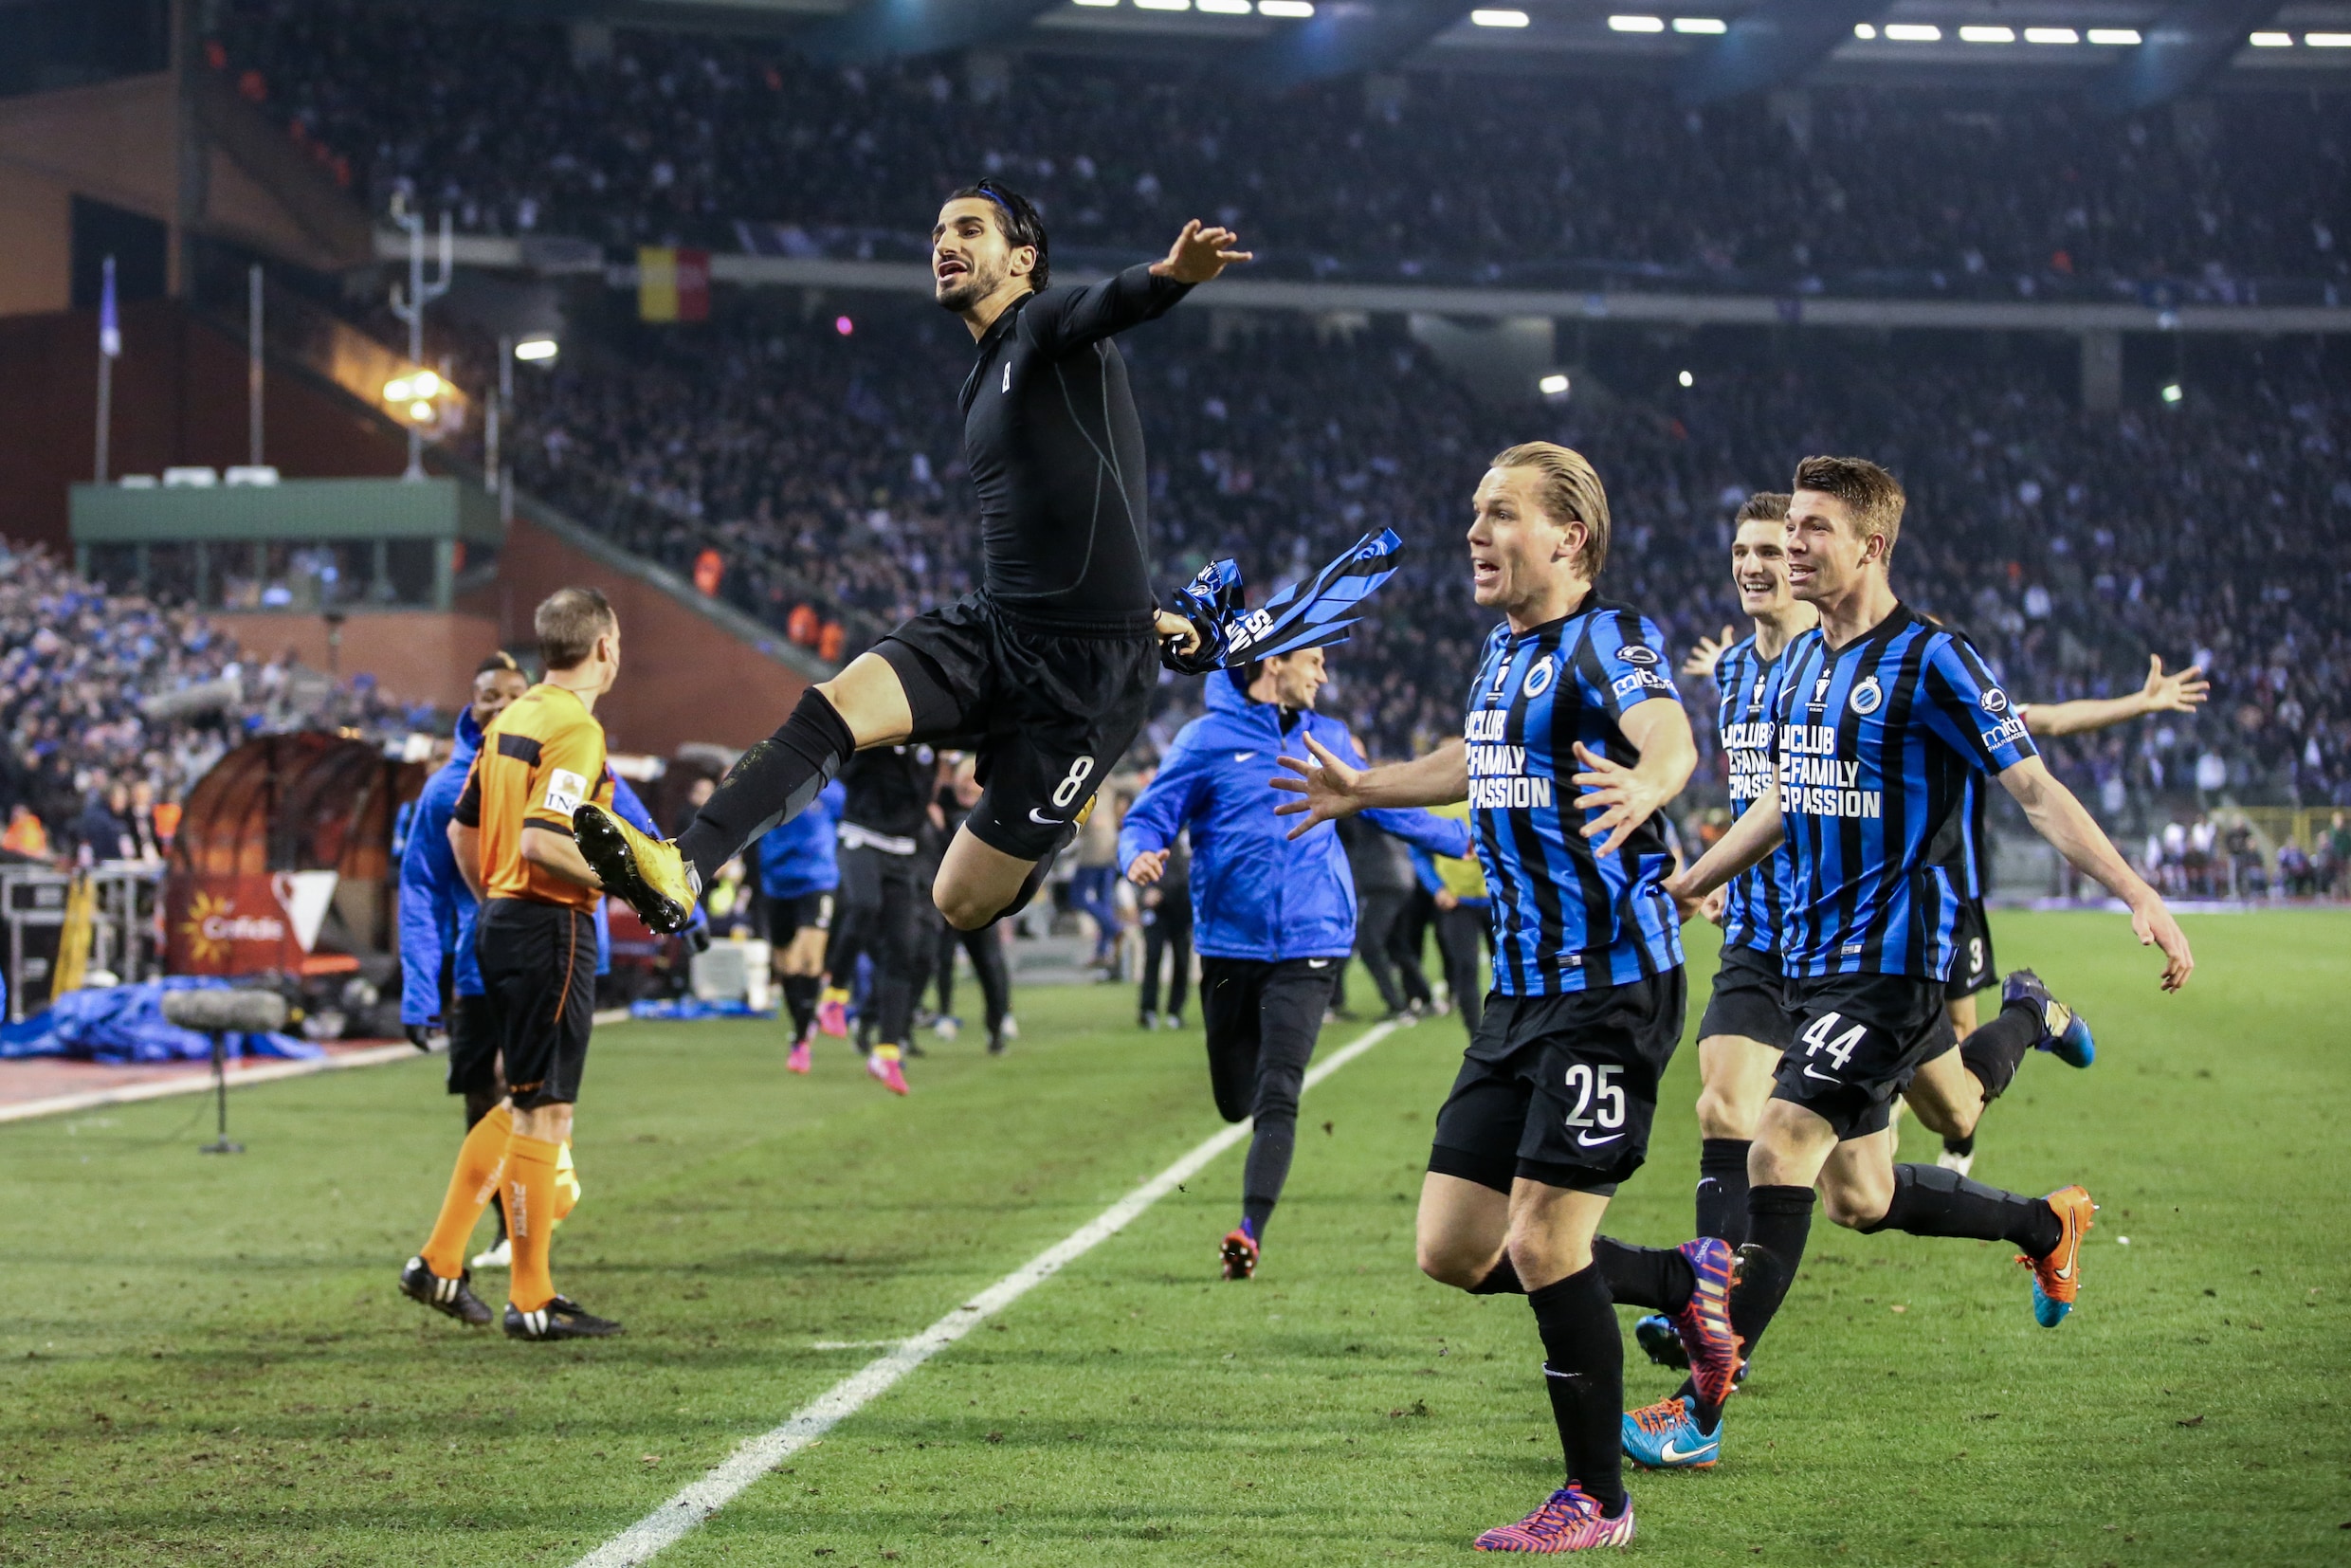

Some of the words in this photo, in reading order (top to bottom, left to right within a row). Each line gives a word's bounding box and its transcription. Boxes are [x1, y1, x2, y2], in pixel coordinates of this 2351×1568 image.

[1470, 710, 1507, 741] CLUB
[1732, 721, 1769, 750] CLUB
[1790, 724, 1835, 756] CLUB
[1470, 745, 1526, 775] FAMILY
[1733, 748, 1772, 775] FAMI
[1791, 757, 1860, 789] FAMILY
[1052, 755, 1095, 808] 8
[1468, 777, 1552, 810] PASSION
[1791, 786, 1881, 819] PASSION
[1968, 936, 1984, 974] 3
[1801, 1011, 1868, 1071] 44
[1564, 1064, 1626, 1129] 25
